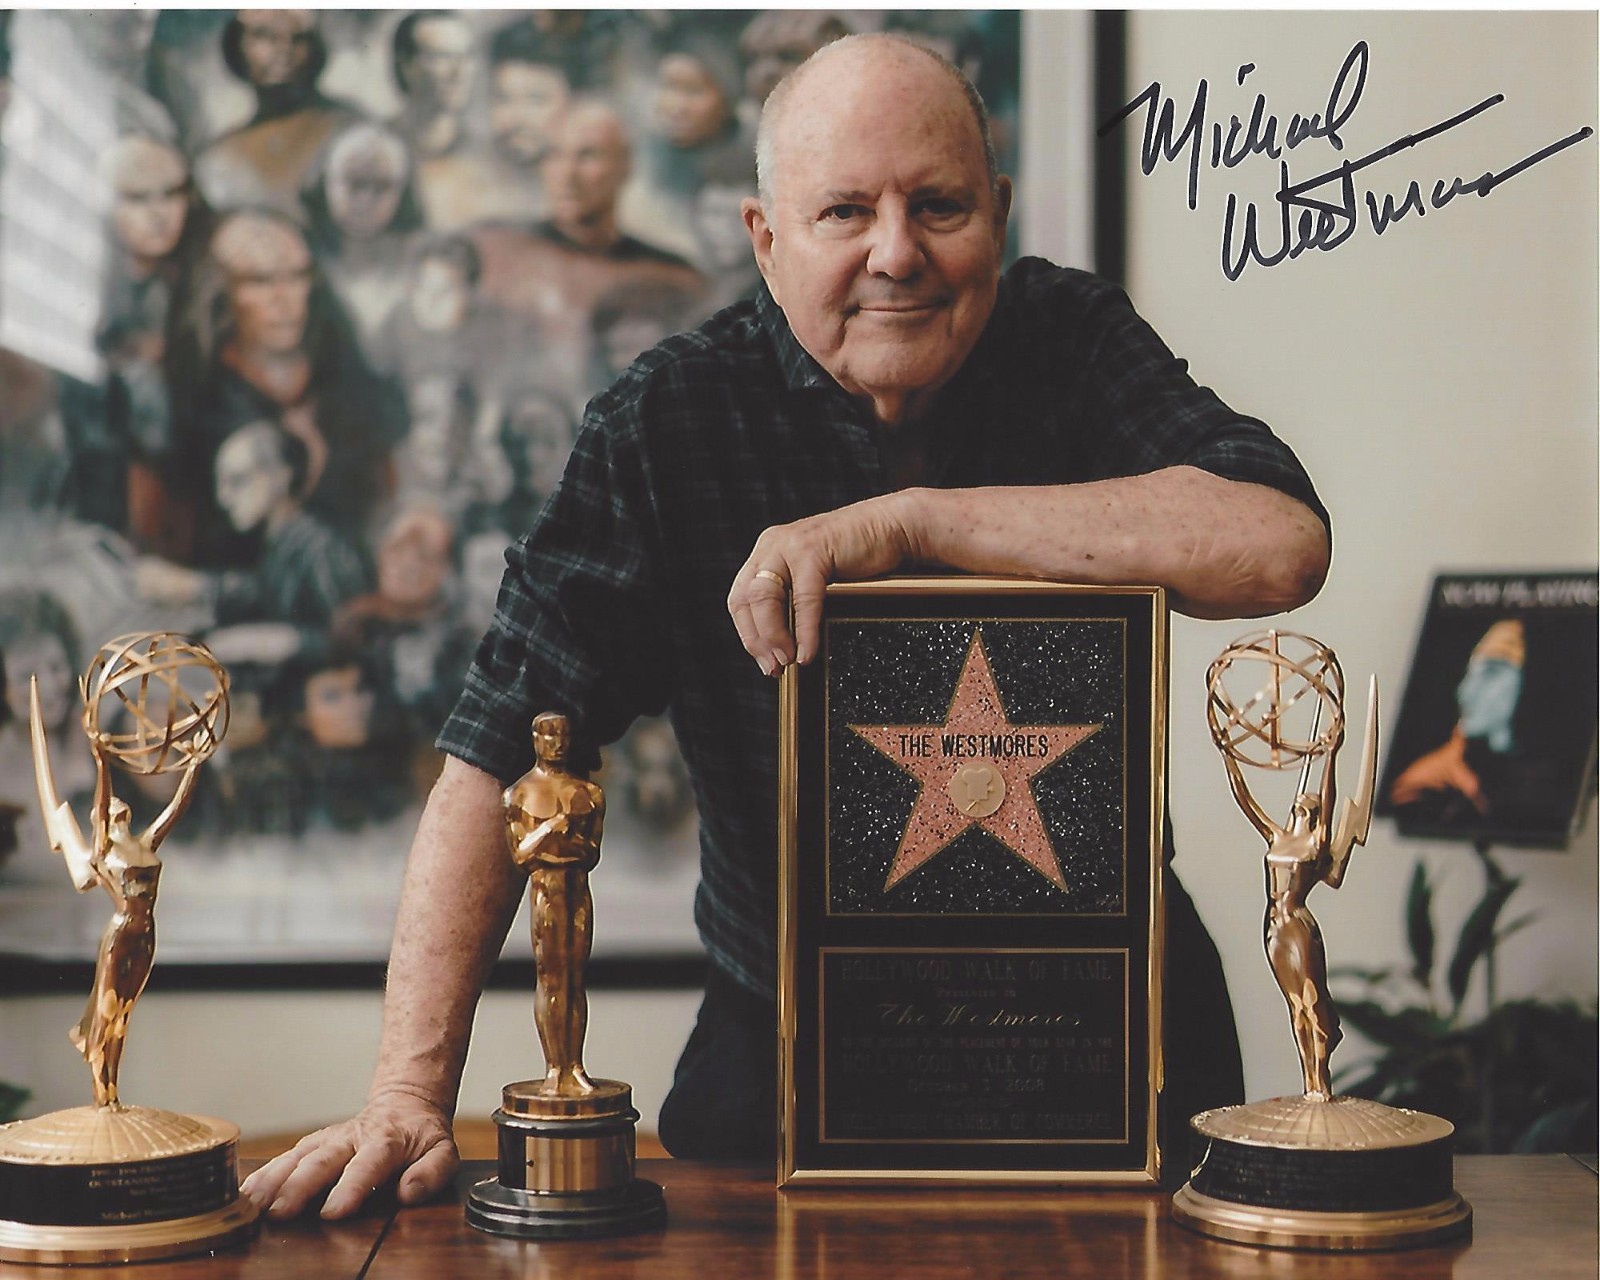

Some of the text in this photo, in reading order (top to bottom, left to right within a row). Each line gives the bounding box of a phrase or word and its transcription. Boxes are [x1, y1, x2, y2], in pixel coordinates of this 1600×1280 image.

[899, 733, 1050, 758] THE WESTMORES
[841, 959, 1112, 981] HOLLYWOOD WALK OF FAME
[876, 1003, 929, 1026] The
[841, 1053, 1112, 1073] HOLLYWOOD WALK OF FAME
[1004, 1078, 1046, 1093] 2008
